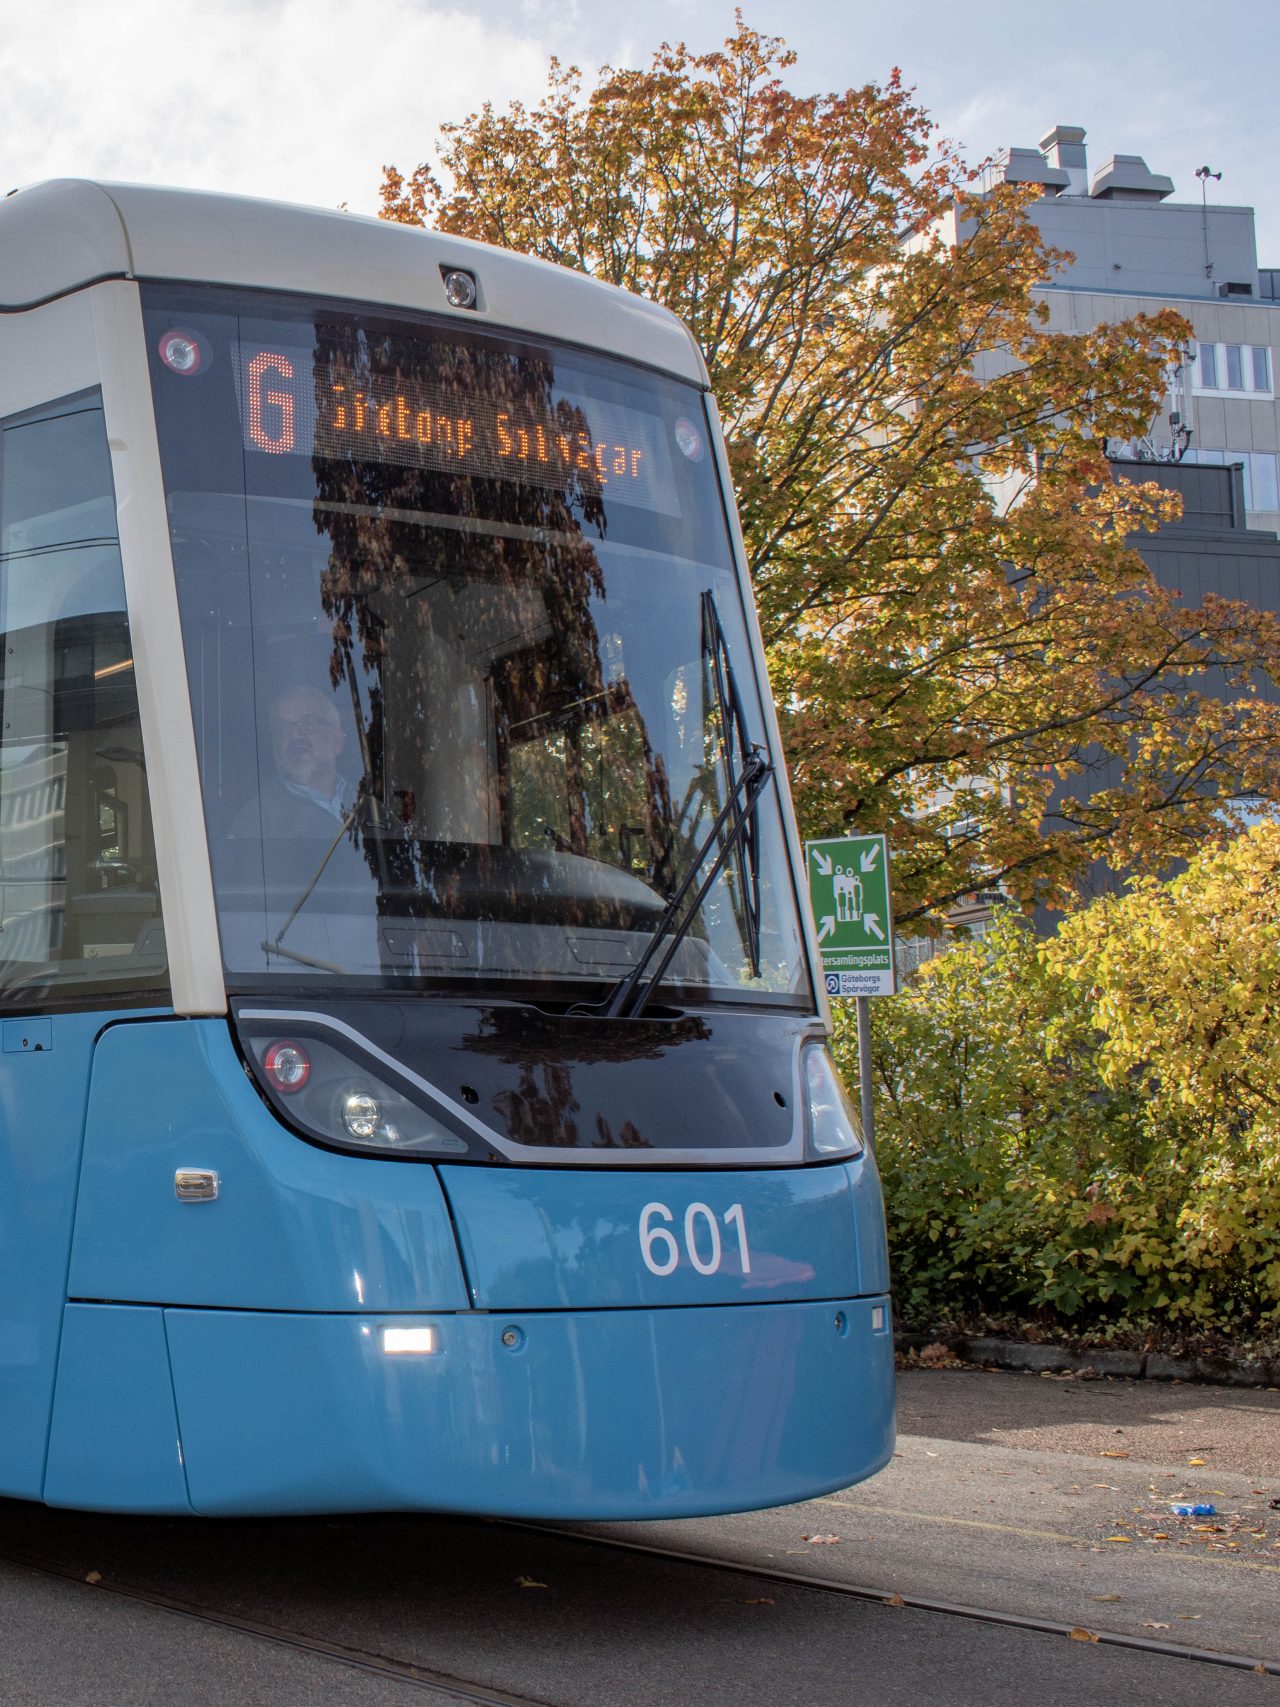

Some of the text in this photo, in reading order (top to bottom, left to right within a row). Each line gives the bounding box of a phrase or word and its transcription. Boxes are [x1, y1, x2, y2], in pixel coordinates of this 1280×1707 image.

[841, 974, 881, 983] Göteborgs
[842, 984, 880, 994] Spårvägar
[639, 1202, 751, 1276] 601
